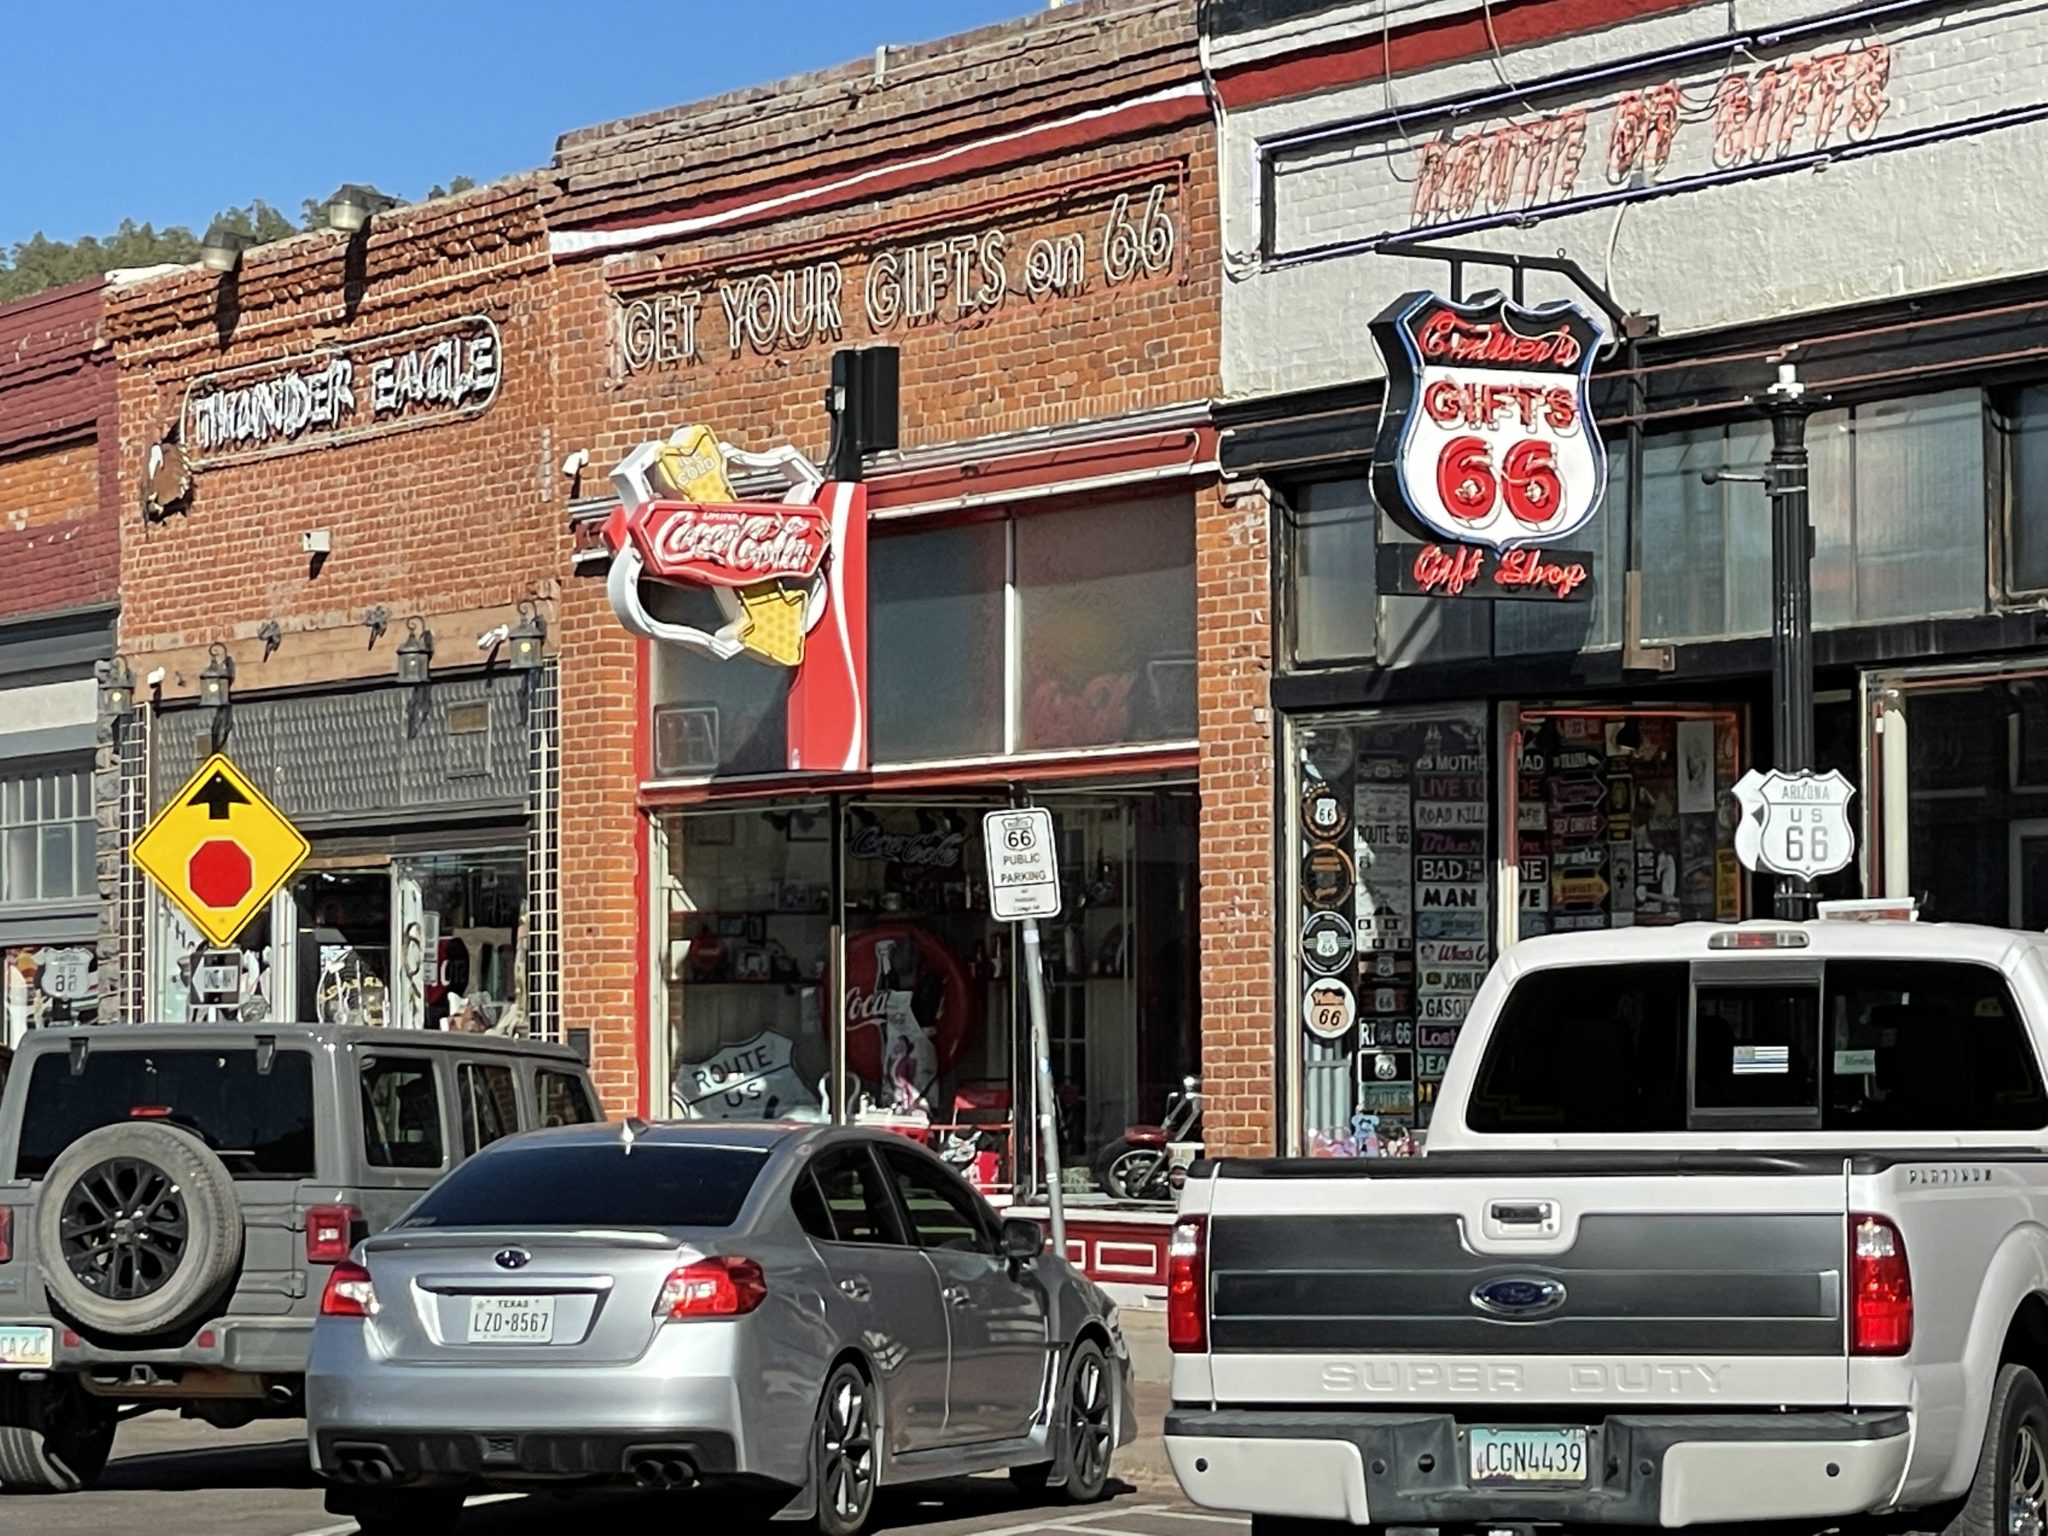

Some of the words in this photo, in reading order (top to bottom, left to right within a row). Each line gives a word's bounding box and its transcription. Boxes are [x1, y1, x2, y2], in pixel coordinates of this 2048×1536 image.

[620, 291, 702, 369] GET
[719, 260, 843, 350] YOUR
[865, 229, 1009, 328] GIFTS
[1025, 230, 1085, 293] on
[1102, 184, 1176, 281] 66
[191, 358, 355, 447] THUNDER
[371, 335, 498, 411] EAGLE
[1424, 378, 1580, 432] GIFTS
[1436, 435, 1564, 526] 66
[1413, 544, 1485, 596] Gift
[1493, 548, 1587, 598] Shop
[1436, 755, 1489, 771] MOTHE
[1419, 778, 1457, 798] LIVE
[1781, 782, 1830, 800] ARIZONA
[1318, 807, 1335, 822] 66
[1419, 805, 1452, 823] ROAD
[1008, 830, 1032, 848] 66
[1785, 825, 1829, 862] 66
[1003, 853, 1041, 866] PUBLIC
[1421, 859, 1464, 880] BAD
[1519, 860, 1543, 881] NE
[1000, 869, 1047, 884] PARKING
[1422, 887, 1478, 908] MAN
[1444, 972, 1473, 990] JOHN
[1319, 1008, 1342, 1026] 66
[1396, 1021, 1411, 1046] 66
[692, 1045, 773, 1092] ROUTE
[1378, 1063, 1395, 1077] 66
[724, 1081, 763, 1108] US
[497, 1299, 529, 1308] TEXAS
[1321, 1361, 1525, 1392] SUPER
[1569, 1362, 1731, 1393] DUTY
[1485, 1441, 1582, 1473] CGN4439
